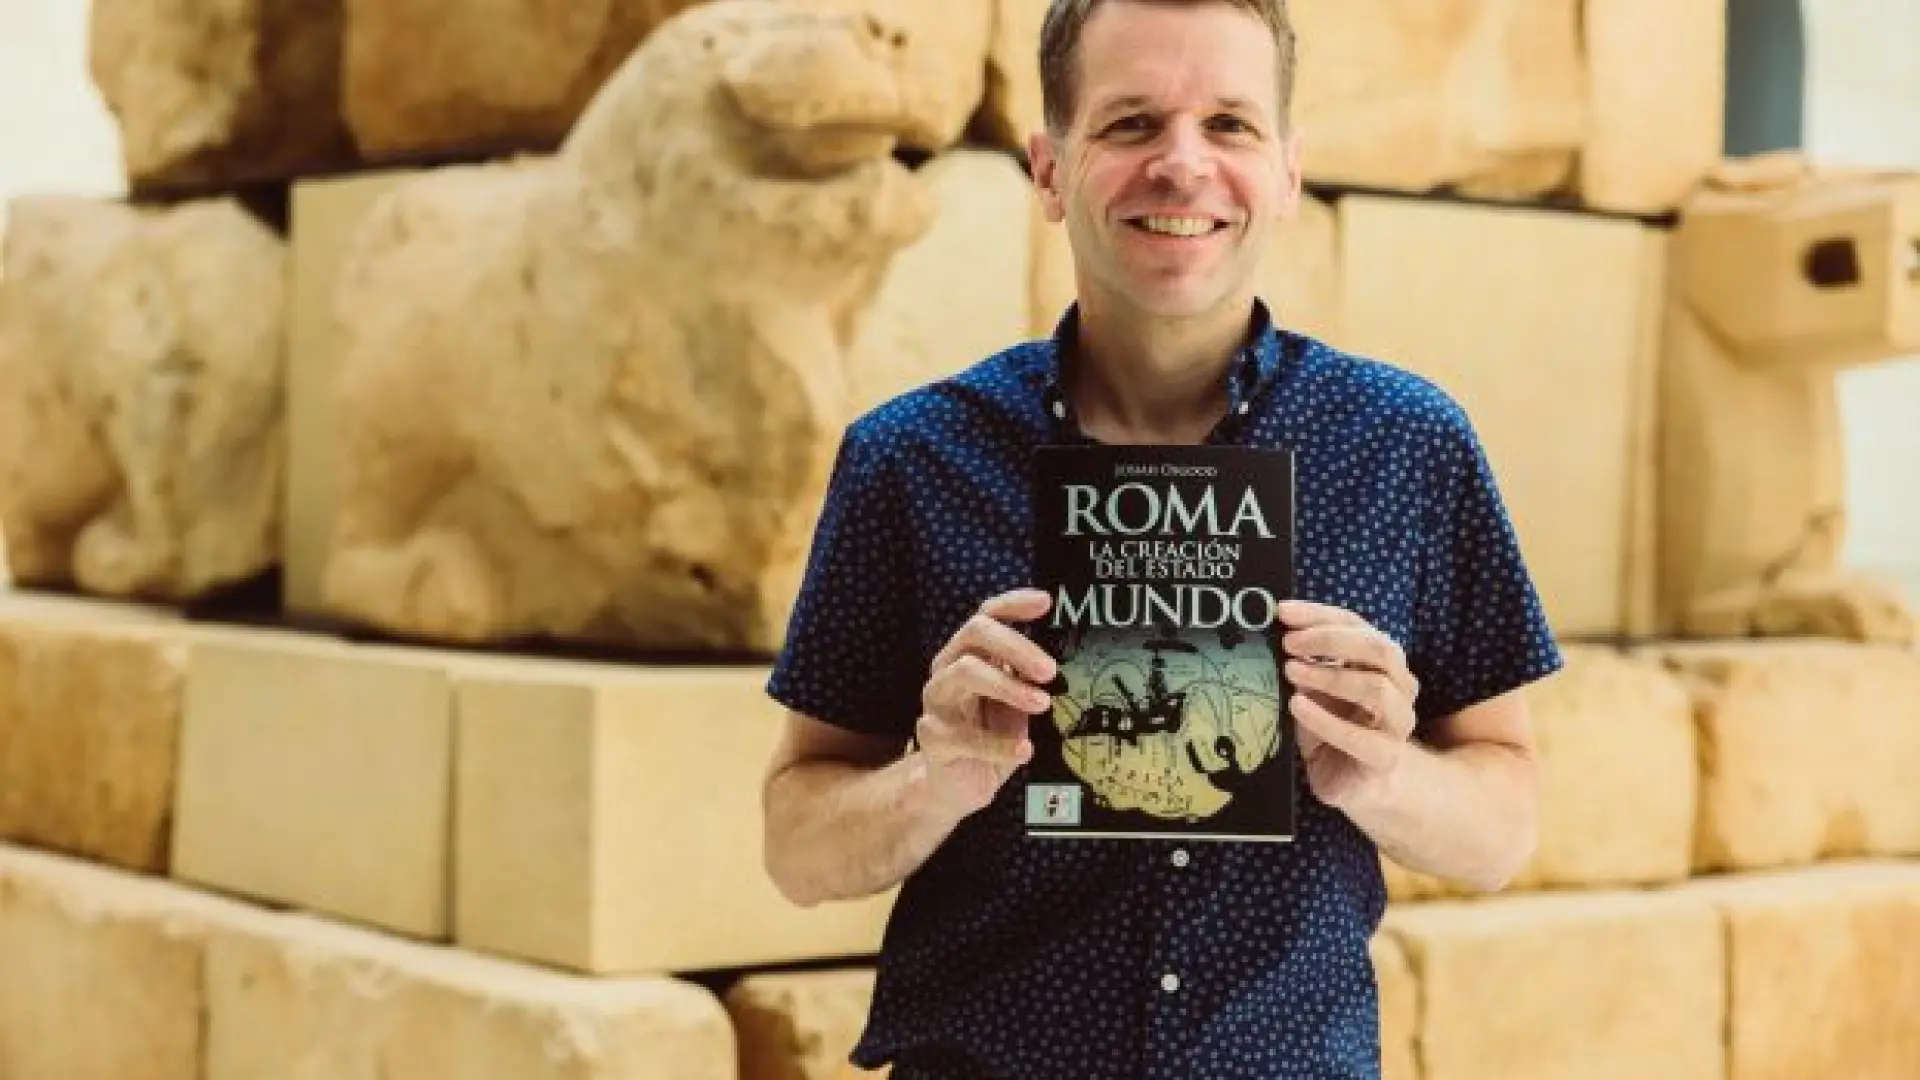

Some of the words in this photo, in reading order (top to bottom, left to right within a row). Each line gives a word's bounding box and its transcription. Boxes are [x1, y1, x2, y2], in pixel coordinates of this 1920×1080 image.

[1064, 482, 1277, 538] ROMA
[1089, 541, 1113, 560] LA
[1120, 538, 1241, 561] CREACIÓN
[1095, 559, 1139, 579] DEL
[1145, 559, 1235, 579] ESTADO
[1050, 584, 1276, 631] MUNDO
